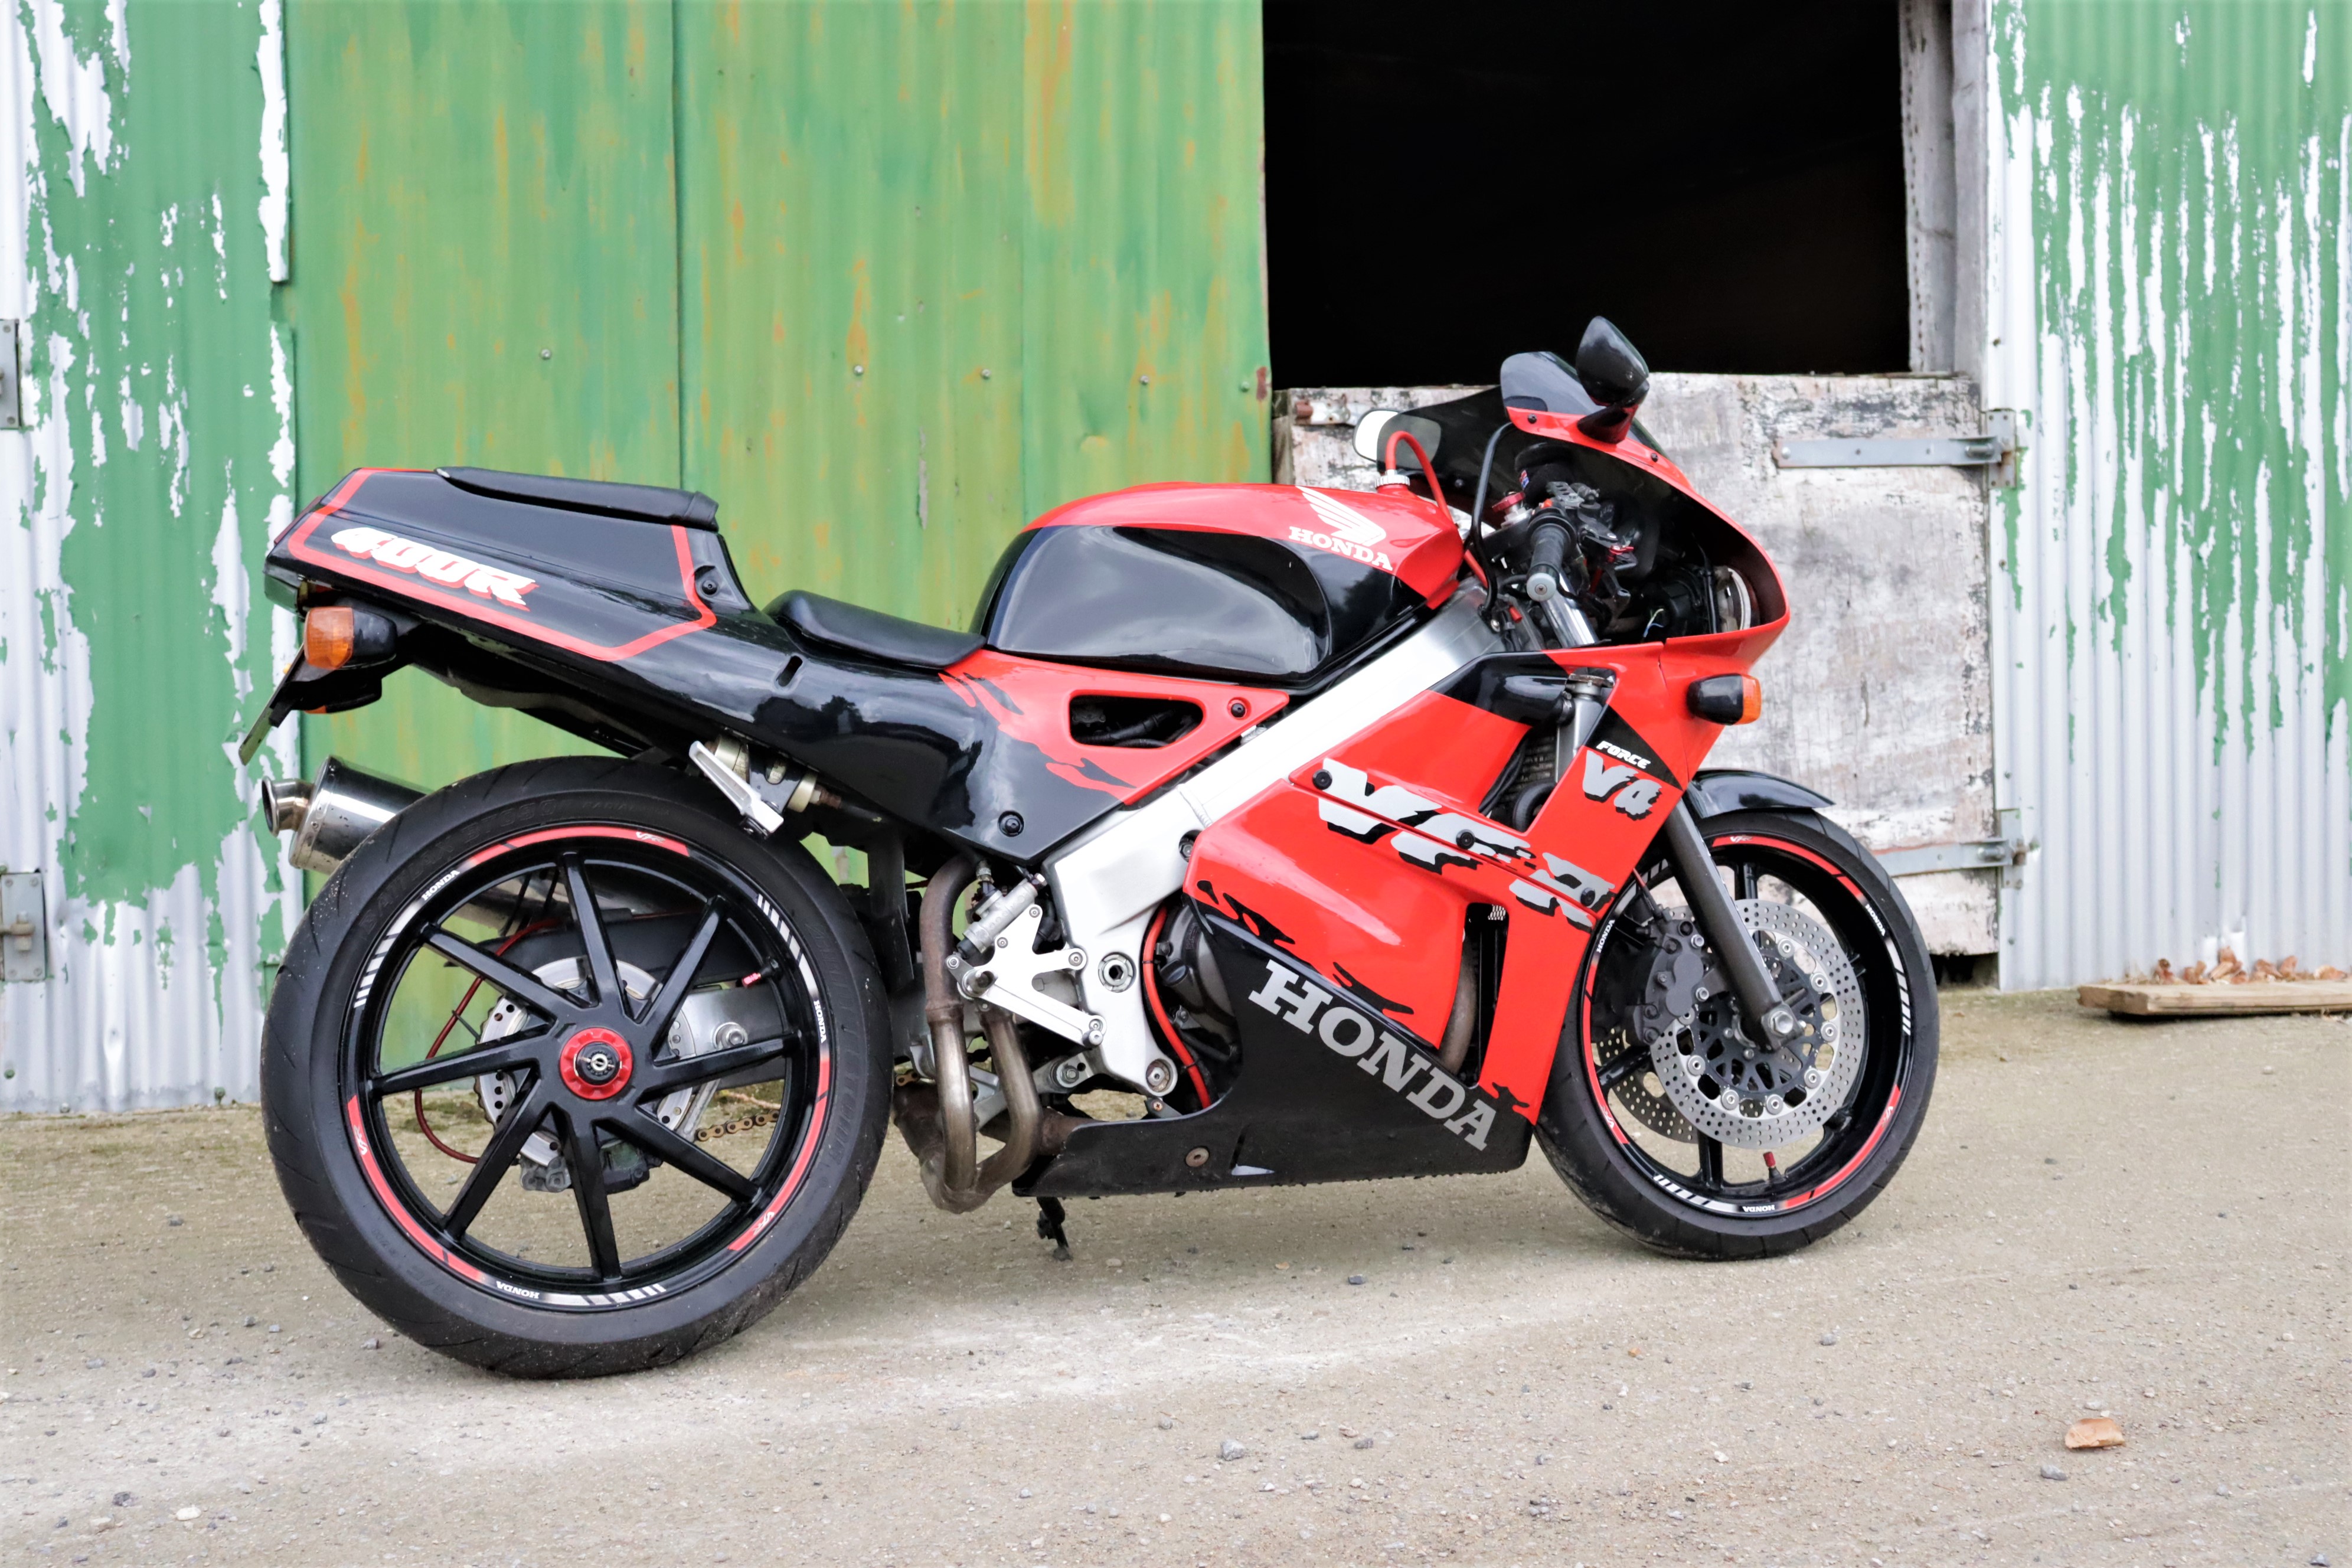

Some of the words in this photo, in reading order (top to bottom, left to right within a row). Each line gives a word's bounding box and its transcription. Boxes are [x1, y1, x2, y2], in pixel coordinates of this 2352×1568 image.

[1289, 527, 1393, 572] HONDA
[331, 527, 538, 612] 400R
[1596, 740, 1651, 770] FORCE
[1582, 750, 1663, 821] V4
[635, 831, 666, 844] VFR
[1318, 757, 1616, 932] VFR
[422, 870, 460, 901] HONDA
[1596, 919, 1616, 953] HONDA
[1865, 904, 1886, 937] HONDA
[814, 999, 827, 1044] HONDA
[1247, 960, 1500, 1152] HONDA
[1742, 1204, 1775, 1213] HONDA
[496, 1280, 540, 1299] HONDA
